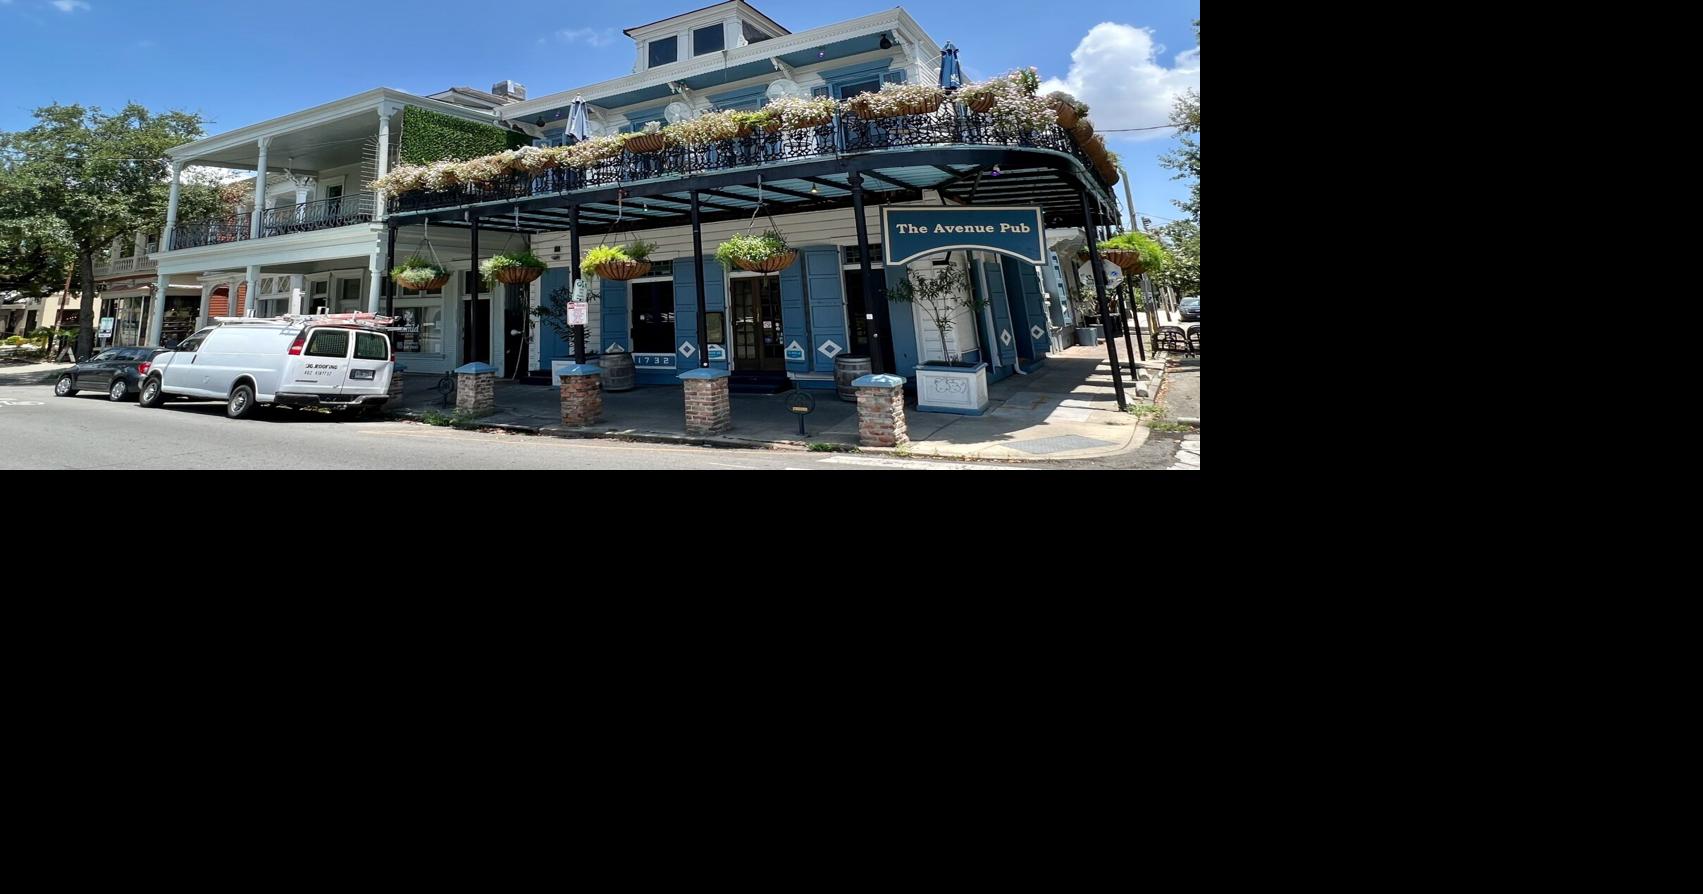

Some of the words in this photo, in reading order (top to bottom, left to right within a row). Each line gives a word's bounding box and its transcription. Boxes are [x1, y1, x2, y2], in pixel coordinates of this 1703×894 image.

[896, 223, 928, 234] The
[933, 223, 995, 233] Avenue
[1000, 223, 1031, 233] Pub
